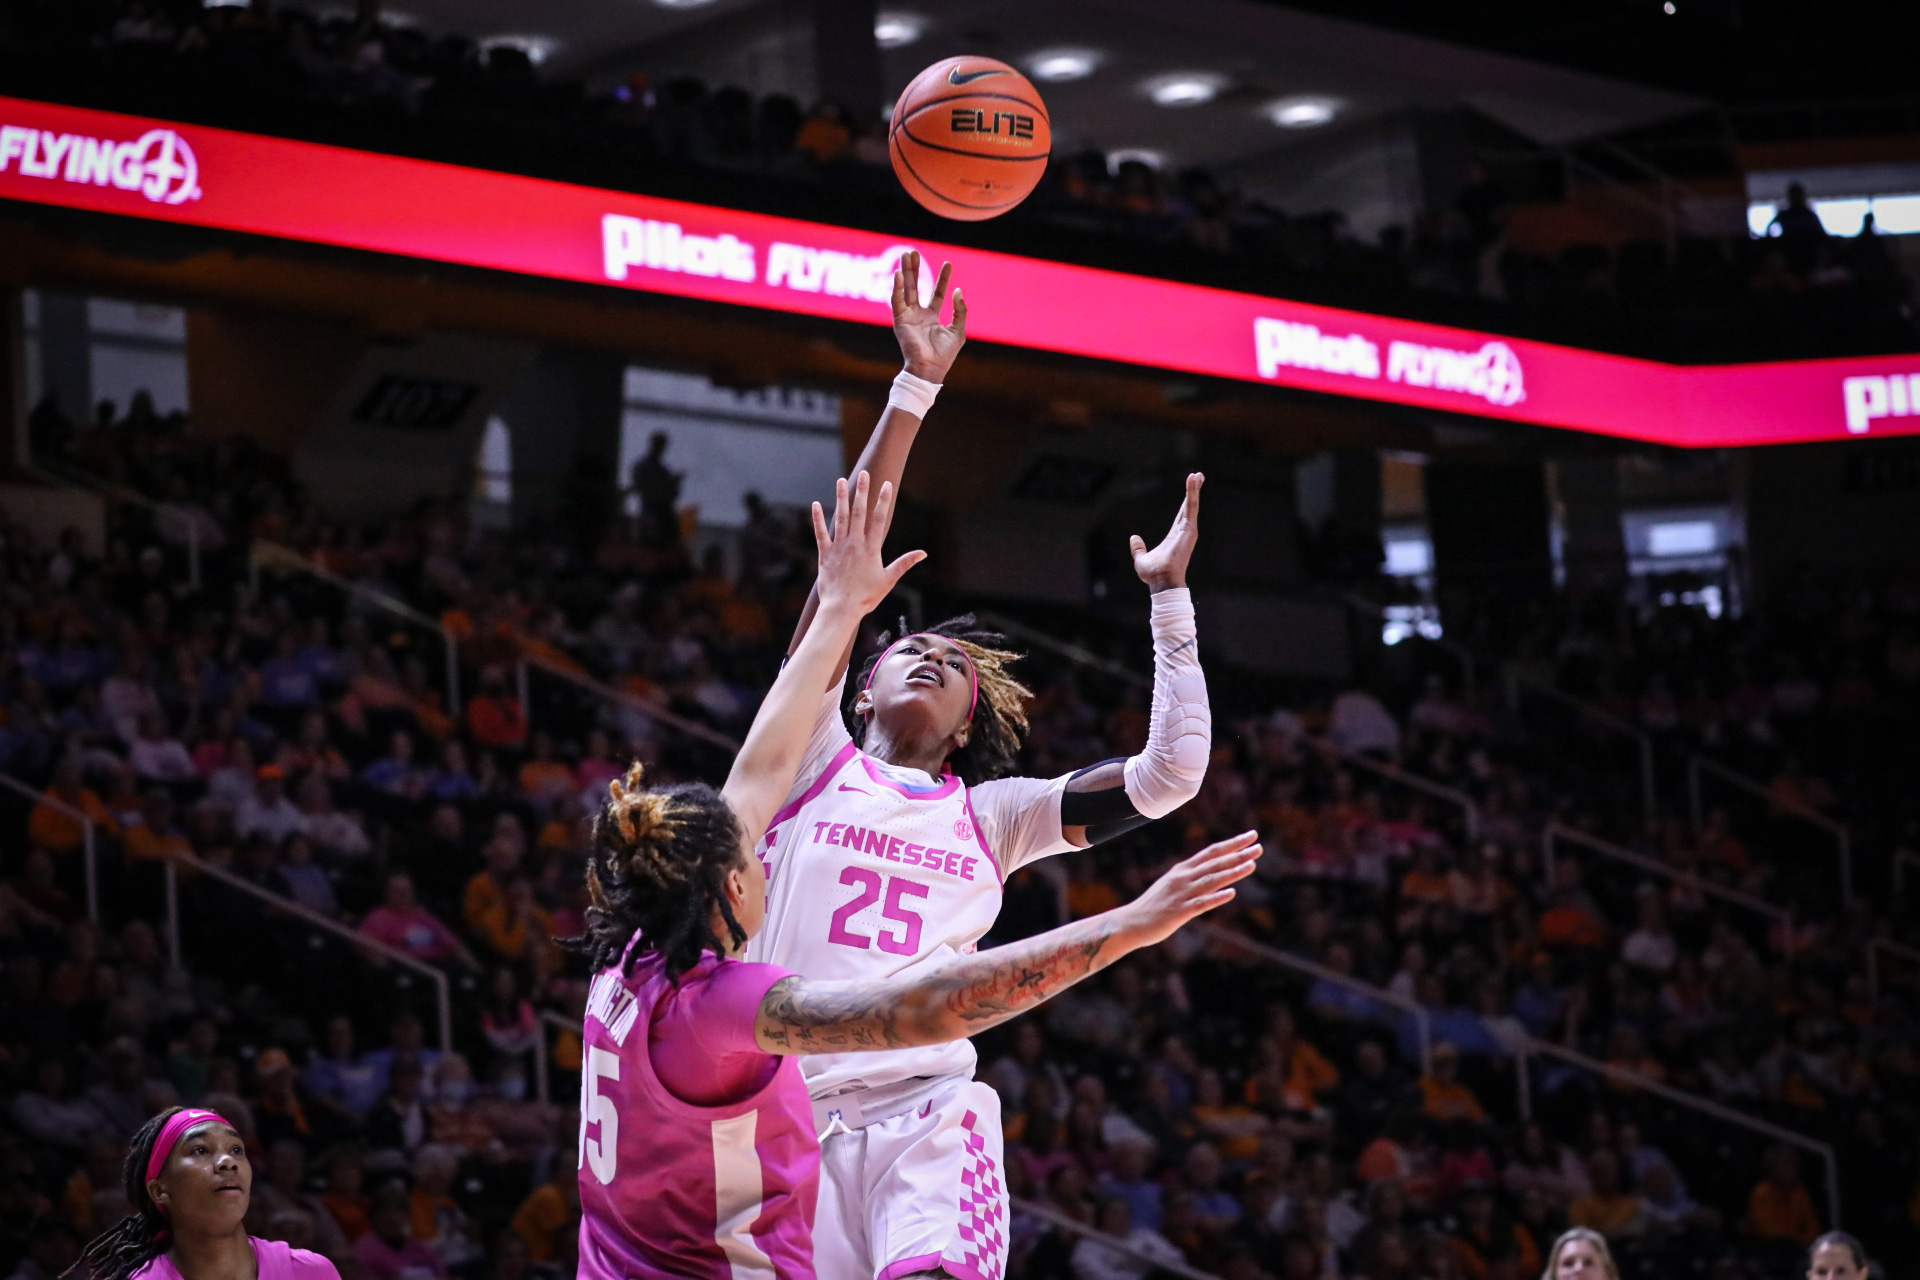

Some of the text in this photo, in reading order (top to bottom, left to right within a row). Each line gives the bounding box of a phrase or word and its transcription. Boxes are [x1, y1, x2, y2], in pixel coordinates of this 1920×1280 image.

[951, 108, 1034, 140] ELITE
[813, 821, 979, 881] TENNESSEE
[828, 865, 930, 957] 25
